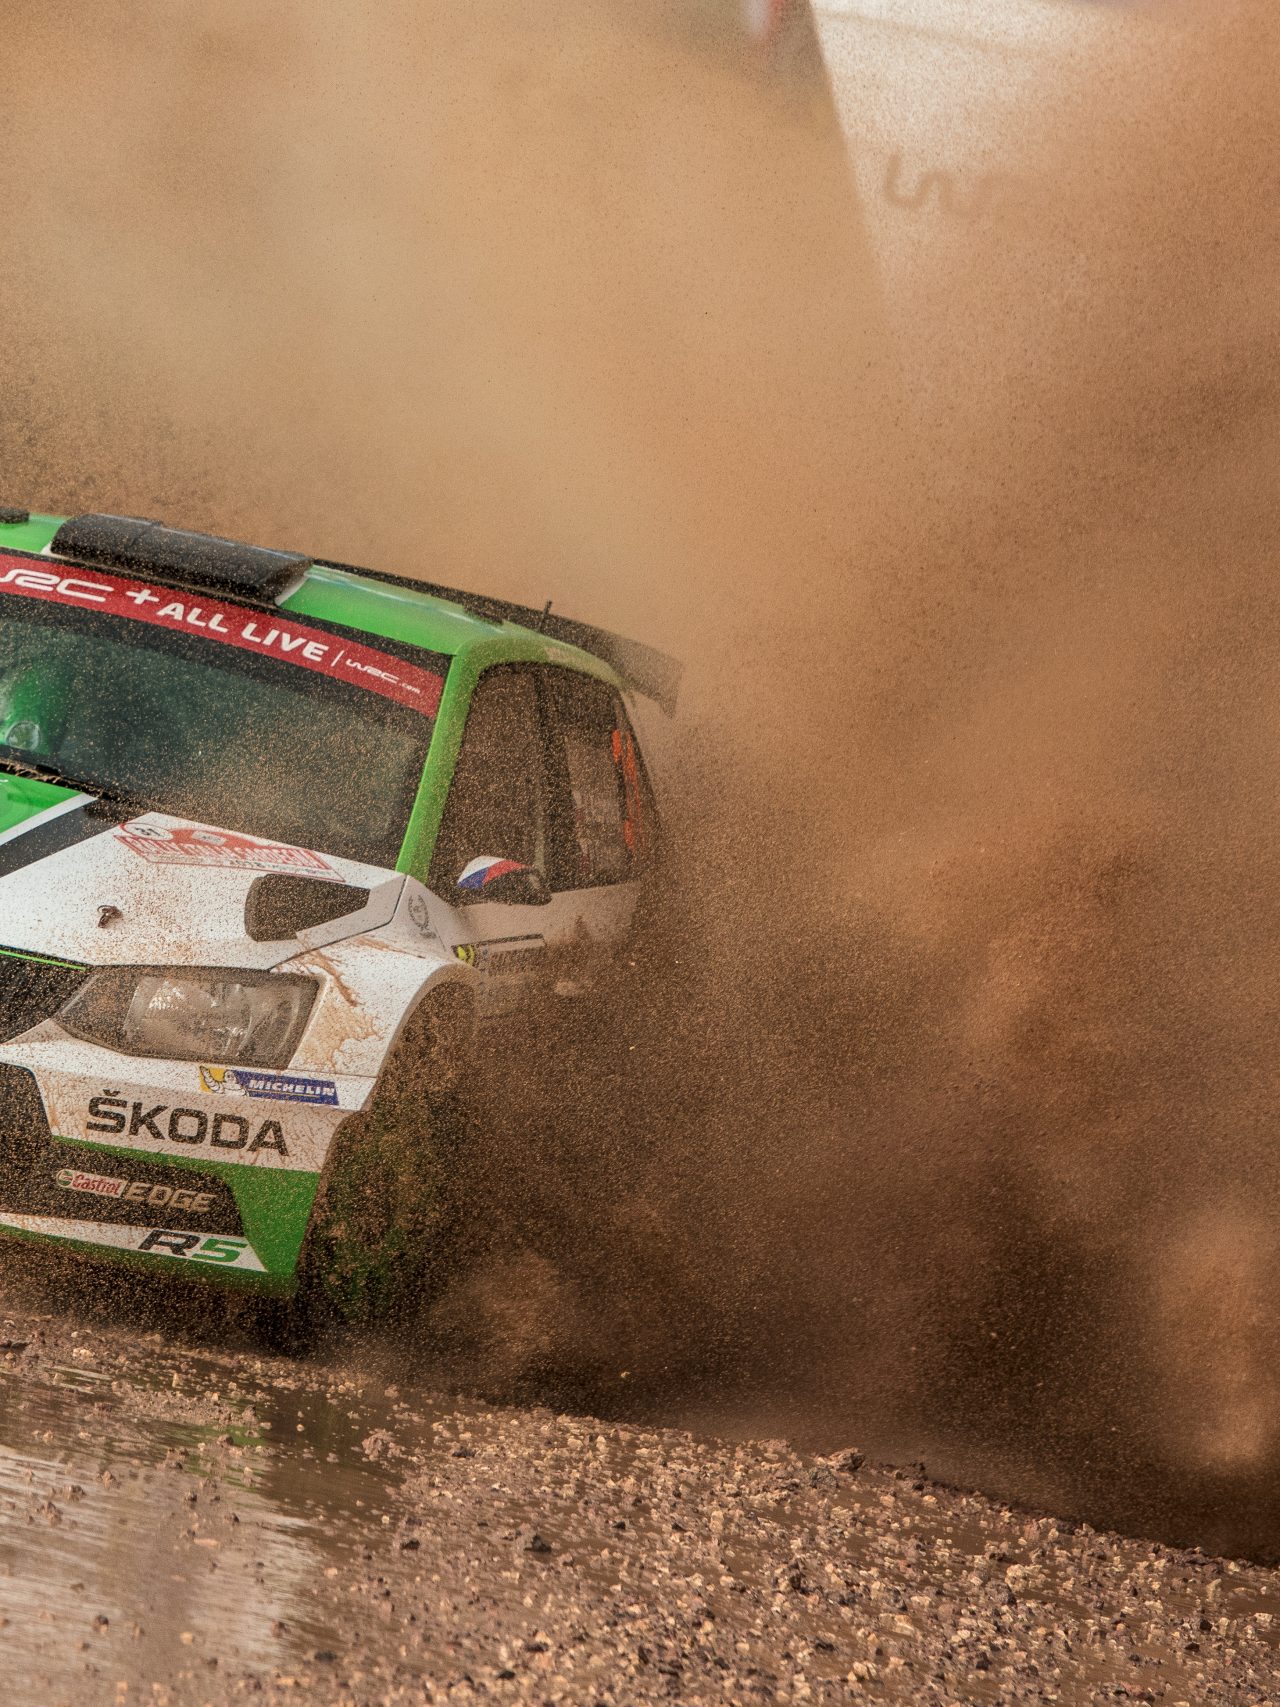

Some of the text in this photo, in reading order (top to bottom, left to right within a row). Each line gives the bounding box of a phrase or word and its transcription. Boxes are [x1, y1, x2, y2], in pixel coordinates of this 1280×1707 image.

[156, 602, 229, 633] ALL
[241, 623, 330, 662] LIVE
[247, 1078, 336, 1098] MICHELIN
[86, 1089, 289, 1157] ŠKODA
[72, 1174, 218, 1213] Castrol EDGE
[138, 1229, 249, 1263] R5
